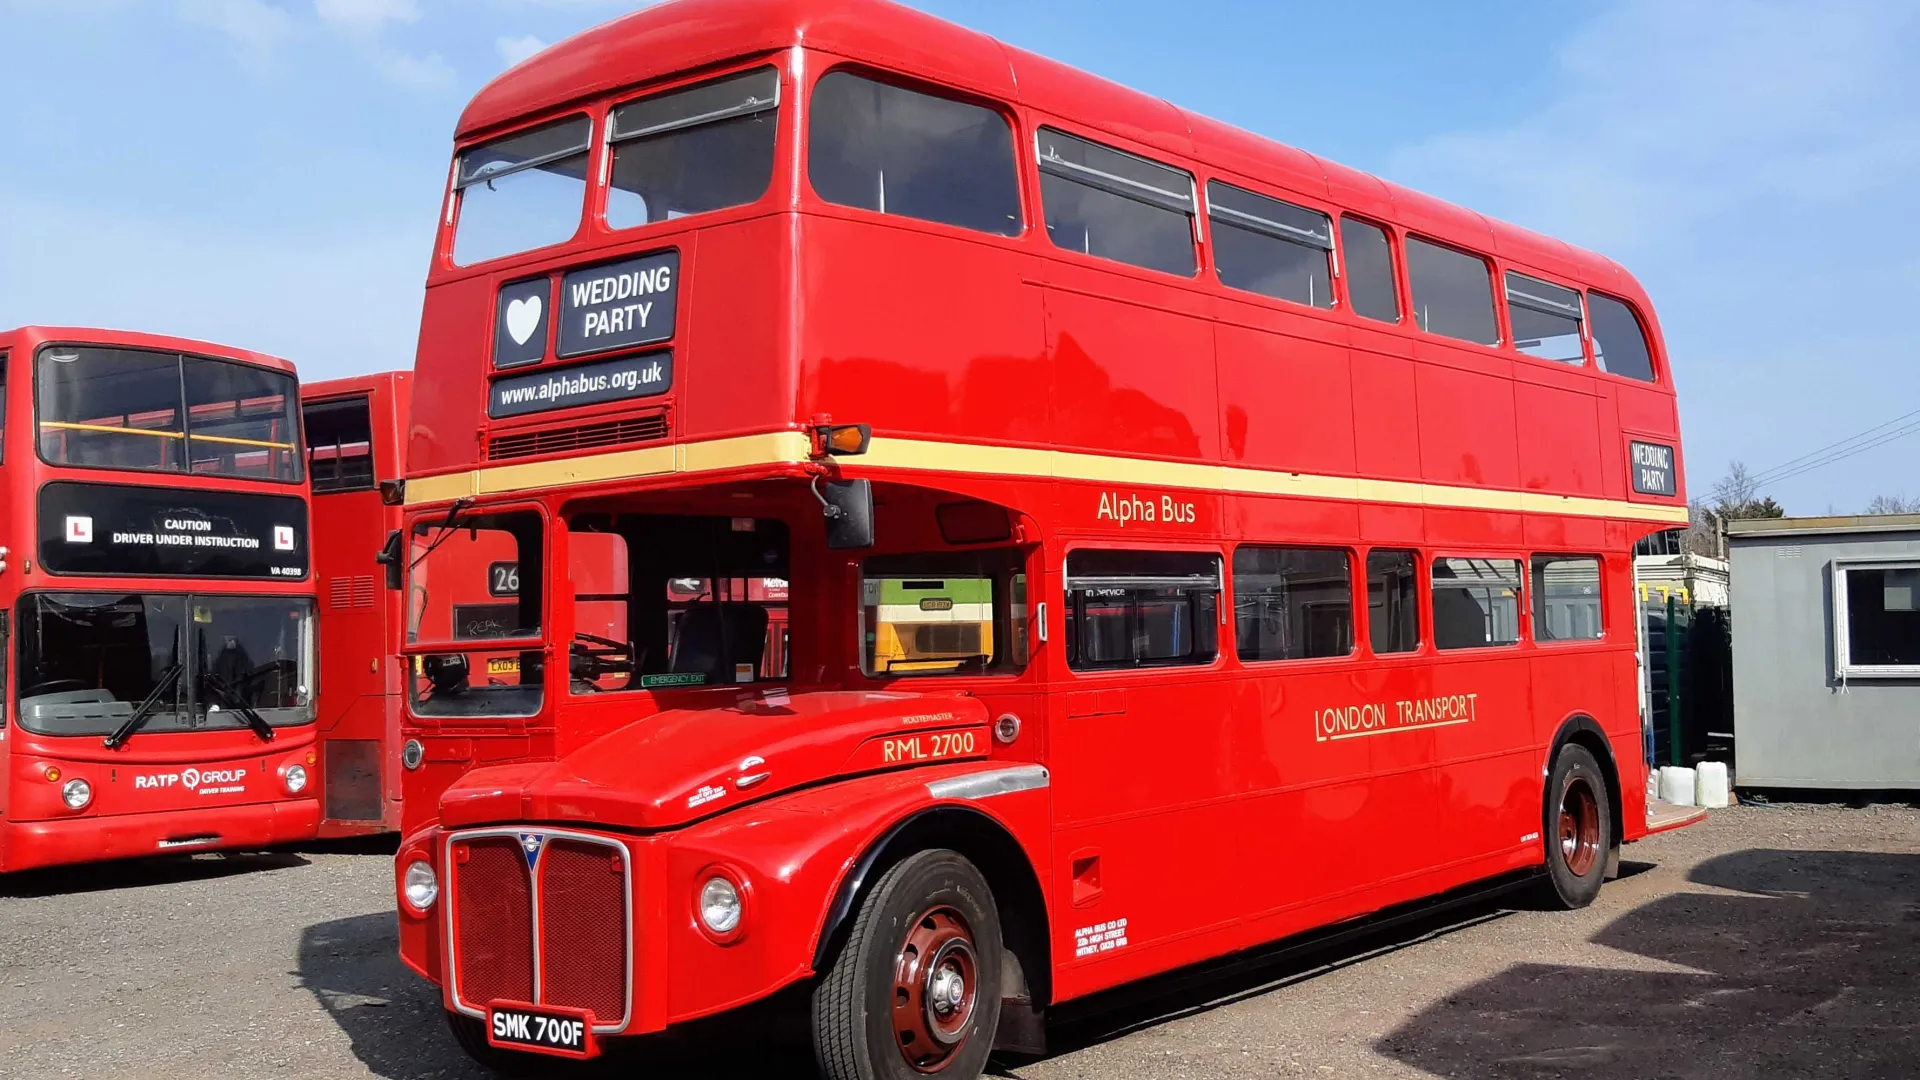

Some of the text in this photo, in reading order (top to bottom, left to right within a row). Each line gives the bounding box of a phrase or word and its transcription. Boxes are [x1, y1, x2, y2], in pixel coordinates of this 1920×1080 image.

[572, 266, 671, 308] WEDDING
[584, 302, 652, 338] PARTY
[501, 362, 662, 405] www.alphabus.org.uk
[1632, 443, 1668, 469] WEDDING
[1641, 469, 1665, 491] PARTY
[1097, 491, 1195, 527] Alpha Bus
[74, 523, 85, 536] L
[164, 519, 212, 531] CAUTION
[113, 533, 259, 548] DRIVER UNDER INSTRUCTION
[280, 532, 289, 544] L
[270, 566, 280, 575] VA
[495, 566, 519, 591] 26
[650, 675, 688, 684] EMERGENCY
[902, 712, 953, 725] ROUTEMASTER
[1315, 693, 1477, 742] LONDON TRANSPORT
[884, 732, 974, 762] RML 2700
[135, 769, 246, 788] RATP GROUP
[199, 787, 219, 795] DRIVER
[1075, 918, 1127, 937] ALPHA BUS CO LTD
[1089, 933, 1104, 944] HIGH
[1104, 927, 1125, 940] STREET
[493, 1012, 584, 1046] SMK 700F
